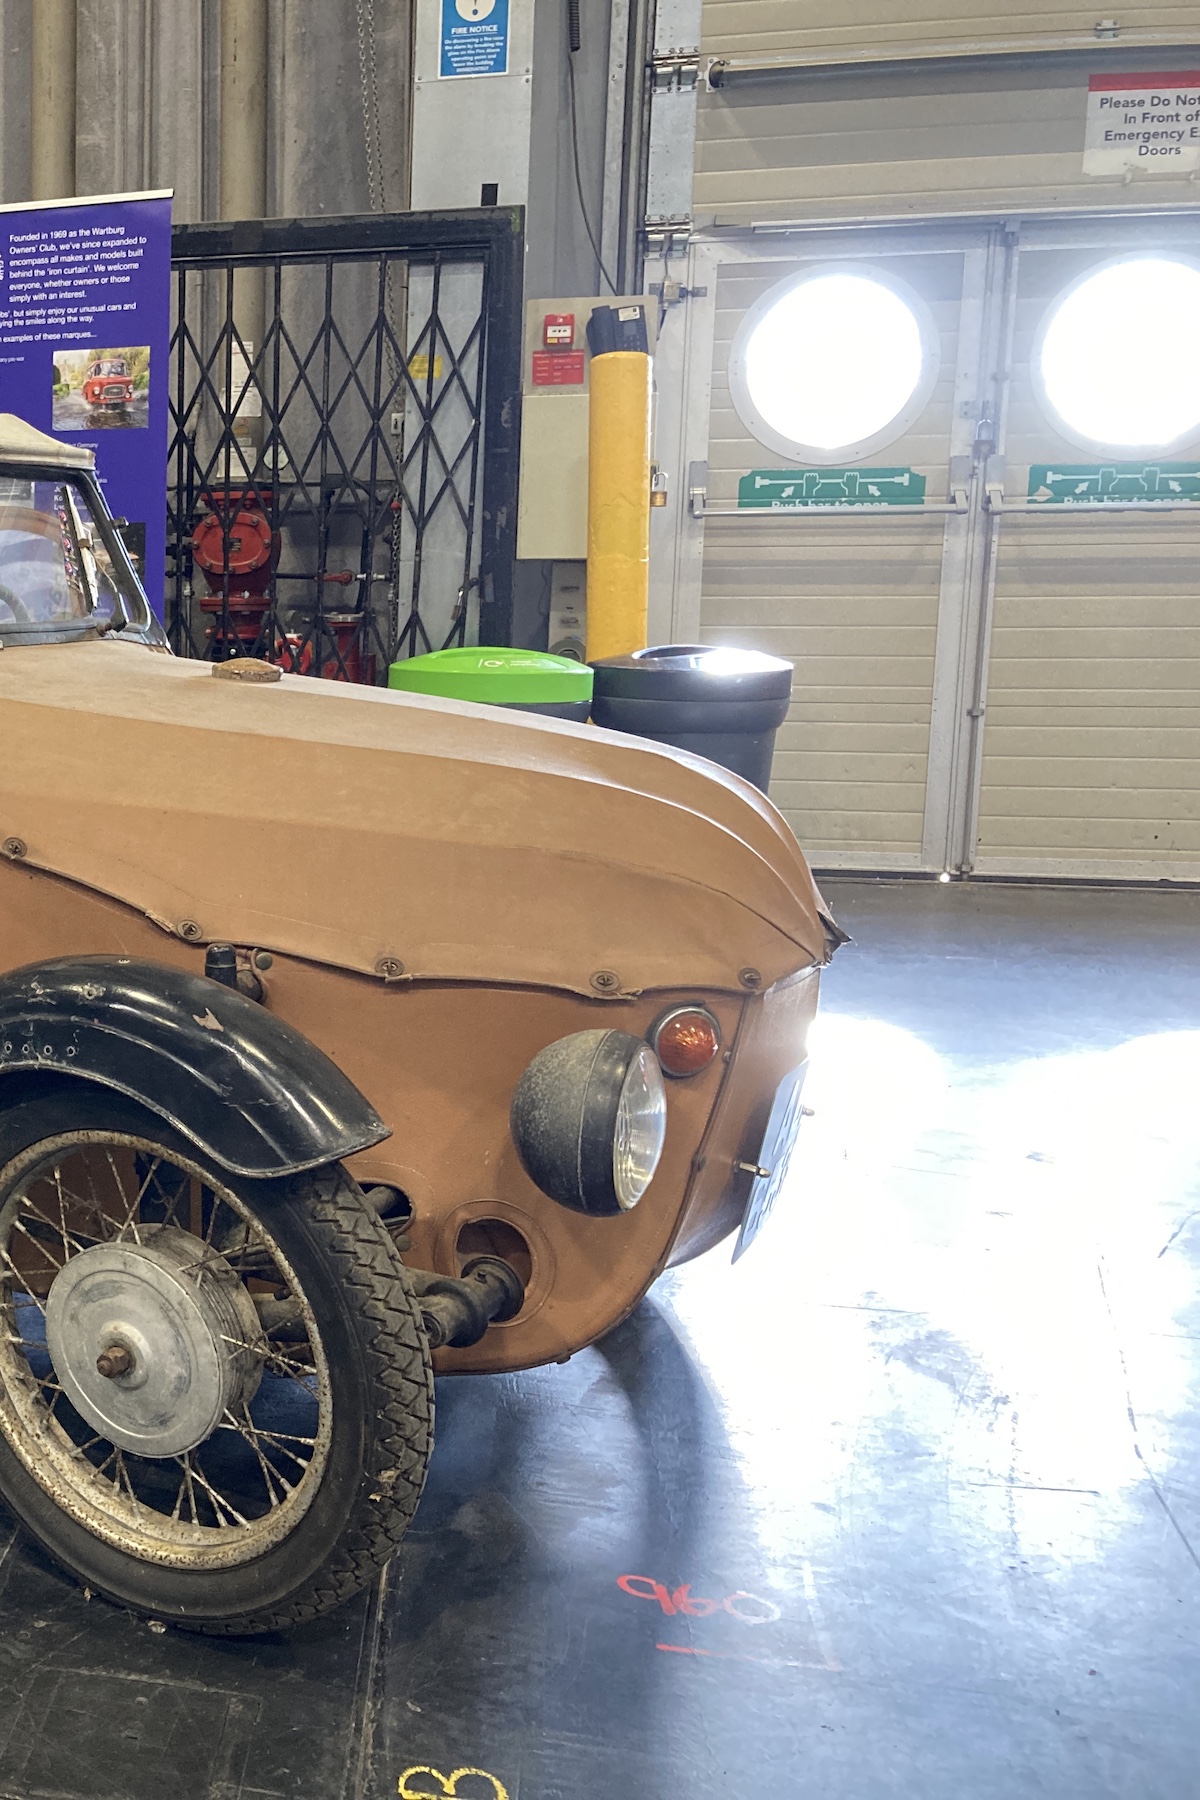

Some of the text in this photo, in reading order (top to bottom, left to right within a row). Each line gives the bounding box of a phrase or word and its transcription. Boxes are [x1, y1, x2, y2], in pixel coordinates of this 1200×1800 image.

[469, 25, 498, 33] NOTICE
[1100, 97, 1145, 108] Please
[1150, 95, 1171, 107] Do
[1124, 110, 1200, 124] In Front of
[1104, 127, 1200, 143] Emergency E
[1138, 145, 1181, 156] Doors
[10, 233, 40, 243] Founded
[41, 232, 48, 240] in
[50, 230, 67, 239] 1969
[68, 230, 77, 238] as
[91, 227, 125, 236] Wartburg
[59, 242, 80, 250] we've
[81, 241, 100, 249] since
[102, 237, 137, 248] expanded
[9, 249, 143, 267] encompass all makes and models built
[9, 269, 33, 279] behind
[94, 263, 106, 272] We
[107, 261, 139, 271] welcome
[44, 279, 72, 288] whether
[73, 277, 99, 286] owners
[101, 276, 109, 284] or
[110, 275, 130, 283] those
[9, 293, 31, 303] simply
[32, 292, 47, 300] with
[48, 291, 58, 299] an
[13, 309, 24, 317] but
[25, 307, 47, 317] simply
[47, 306, 66, 316] enjoy
[67, 306, 78, 314] our
[79, 304, 106, 313] unusual
[107, 303, 122, 311] cars
[123, 302, 137, 310] and
[13, 318, 24, 326] the
[25, 317, 46, 325] smiles
[47, 316, 66, 325] along
[67, 315, 78, 323] the
[3, 334, 33, 343] examples
[34, 333, 42, 341] of
[43, 332, 61, 340] these
[617, 1574, 781, 1624] 960
